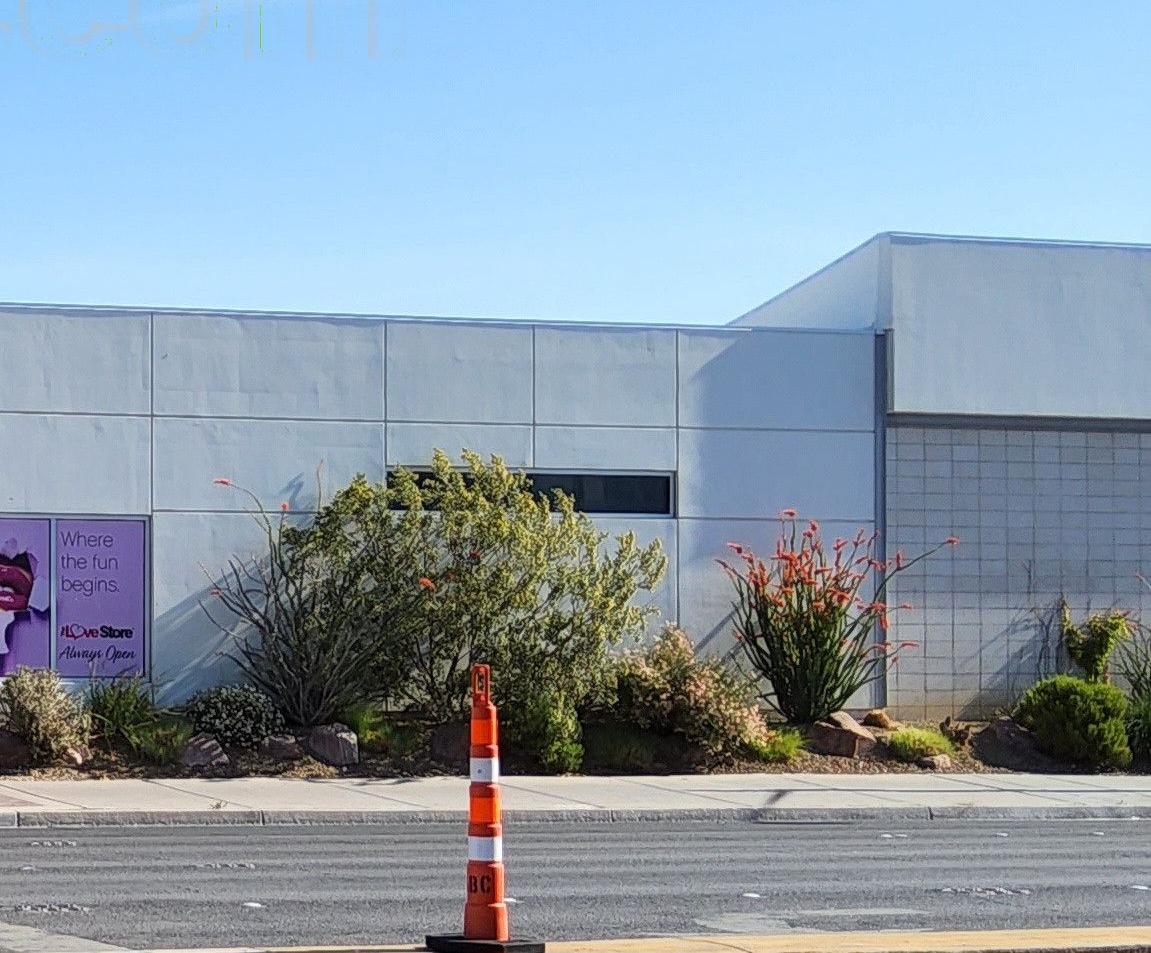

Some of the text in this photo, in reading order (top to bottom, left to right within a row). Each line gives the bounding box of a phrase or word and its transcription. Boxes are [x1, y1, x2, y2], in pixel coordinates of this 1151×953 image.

[60, 531, 114, 548] Where
[60, 553, 119, 570] the fun
[61, 575, 120, 597] begins.
[99, 625, 134, 639] Store
[58, 645, 137, 664] Always Open
[467, 874, 492, 894] BC
